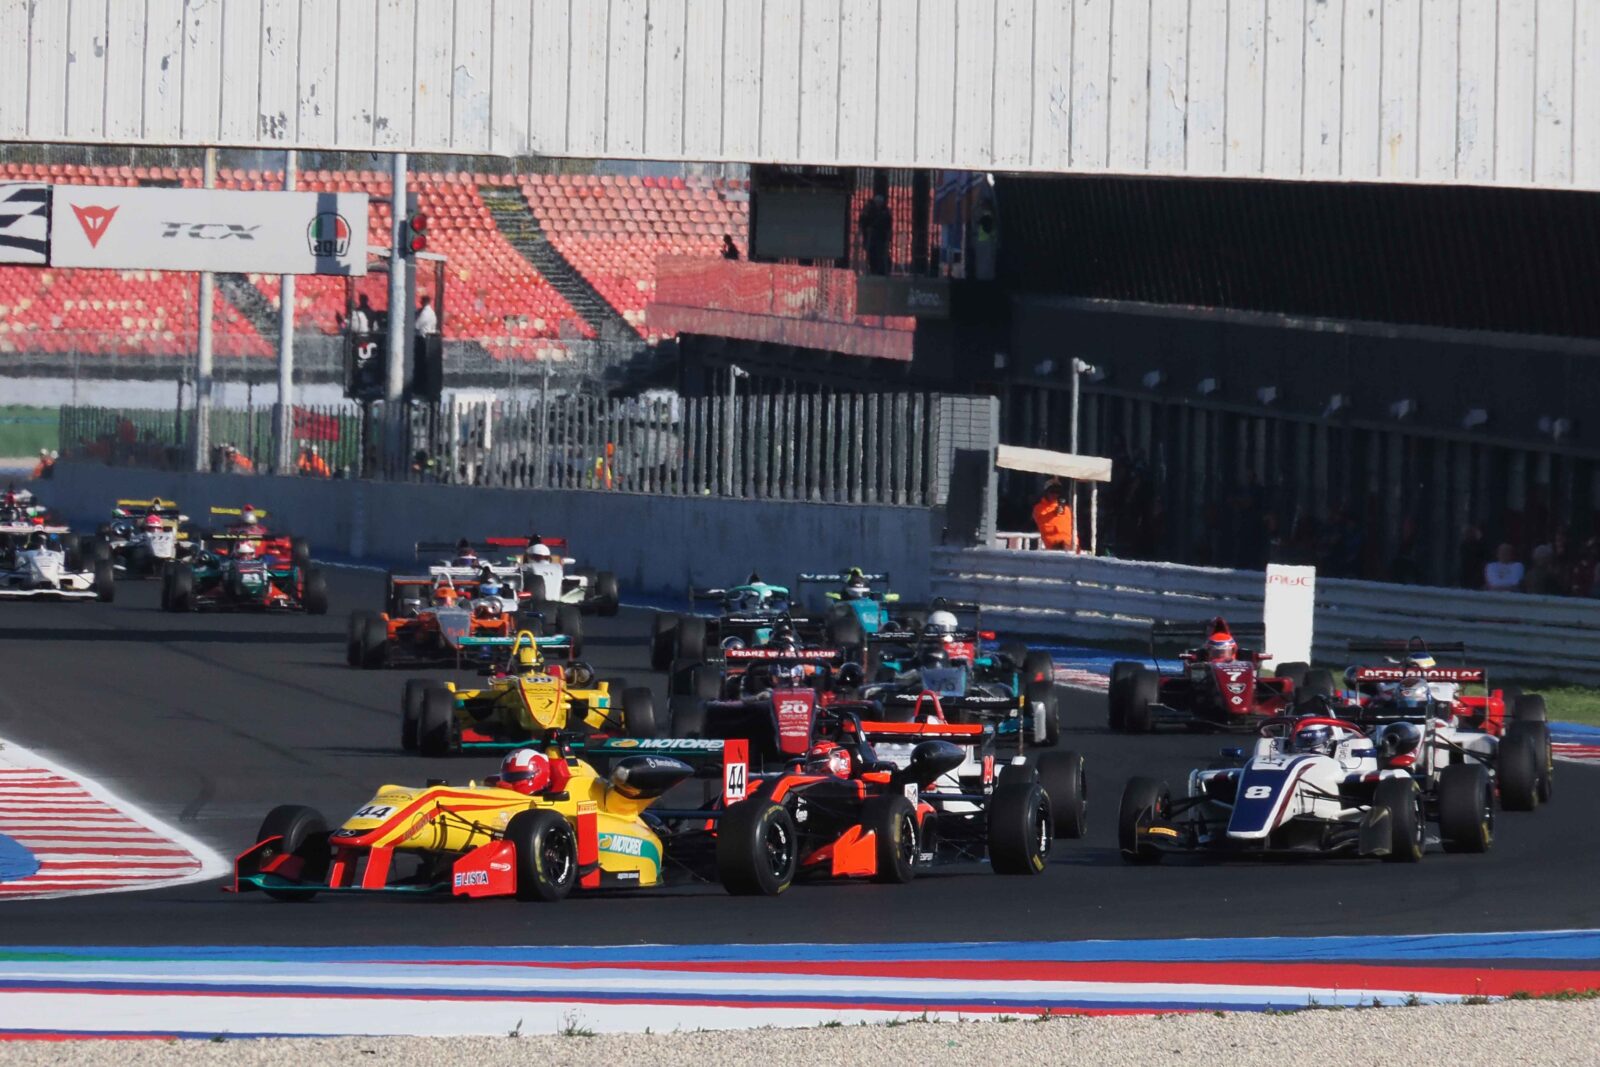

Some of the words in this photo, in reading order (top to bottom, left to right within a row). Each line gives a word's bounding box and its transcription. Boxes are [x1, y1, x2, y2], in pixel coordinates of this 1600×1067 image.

[161, 221, 262, 240] TCX
[1226, 671, 1242, 682] 7
[780, 703, 809, 714] 20
[728, 764, 744, 795] 44
[1244, 785, 1272, 799] 8
[357, 805, 392, 818] 44
[463, 870, 488, 886] LISTA
